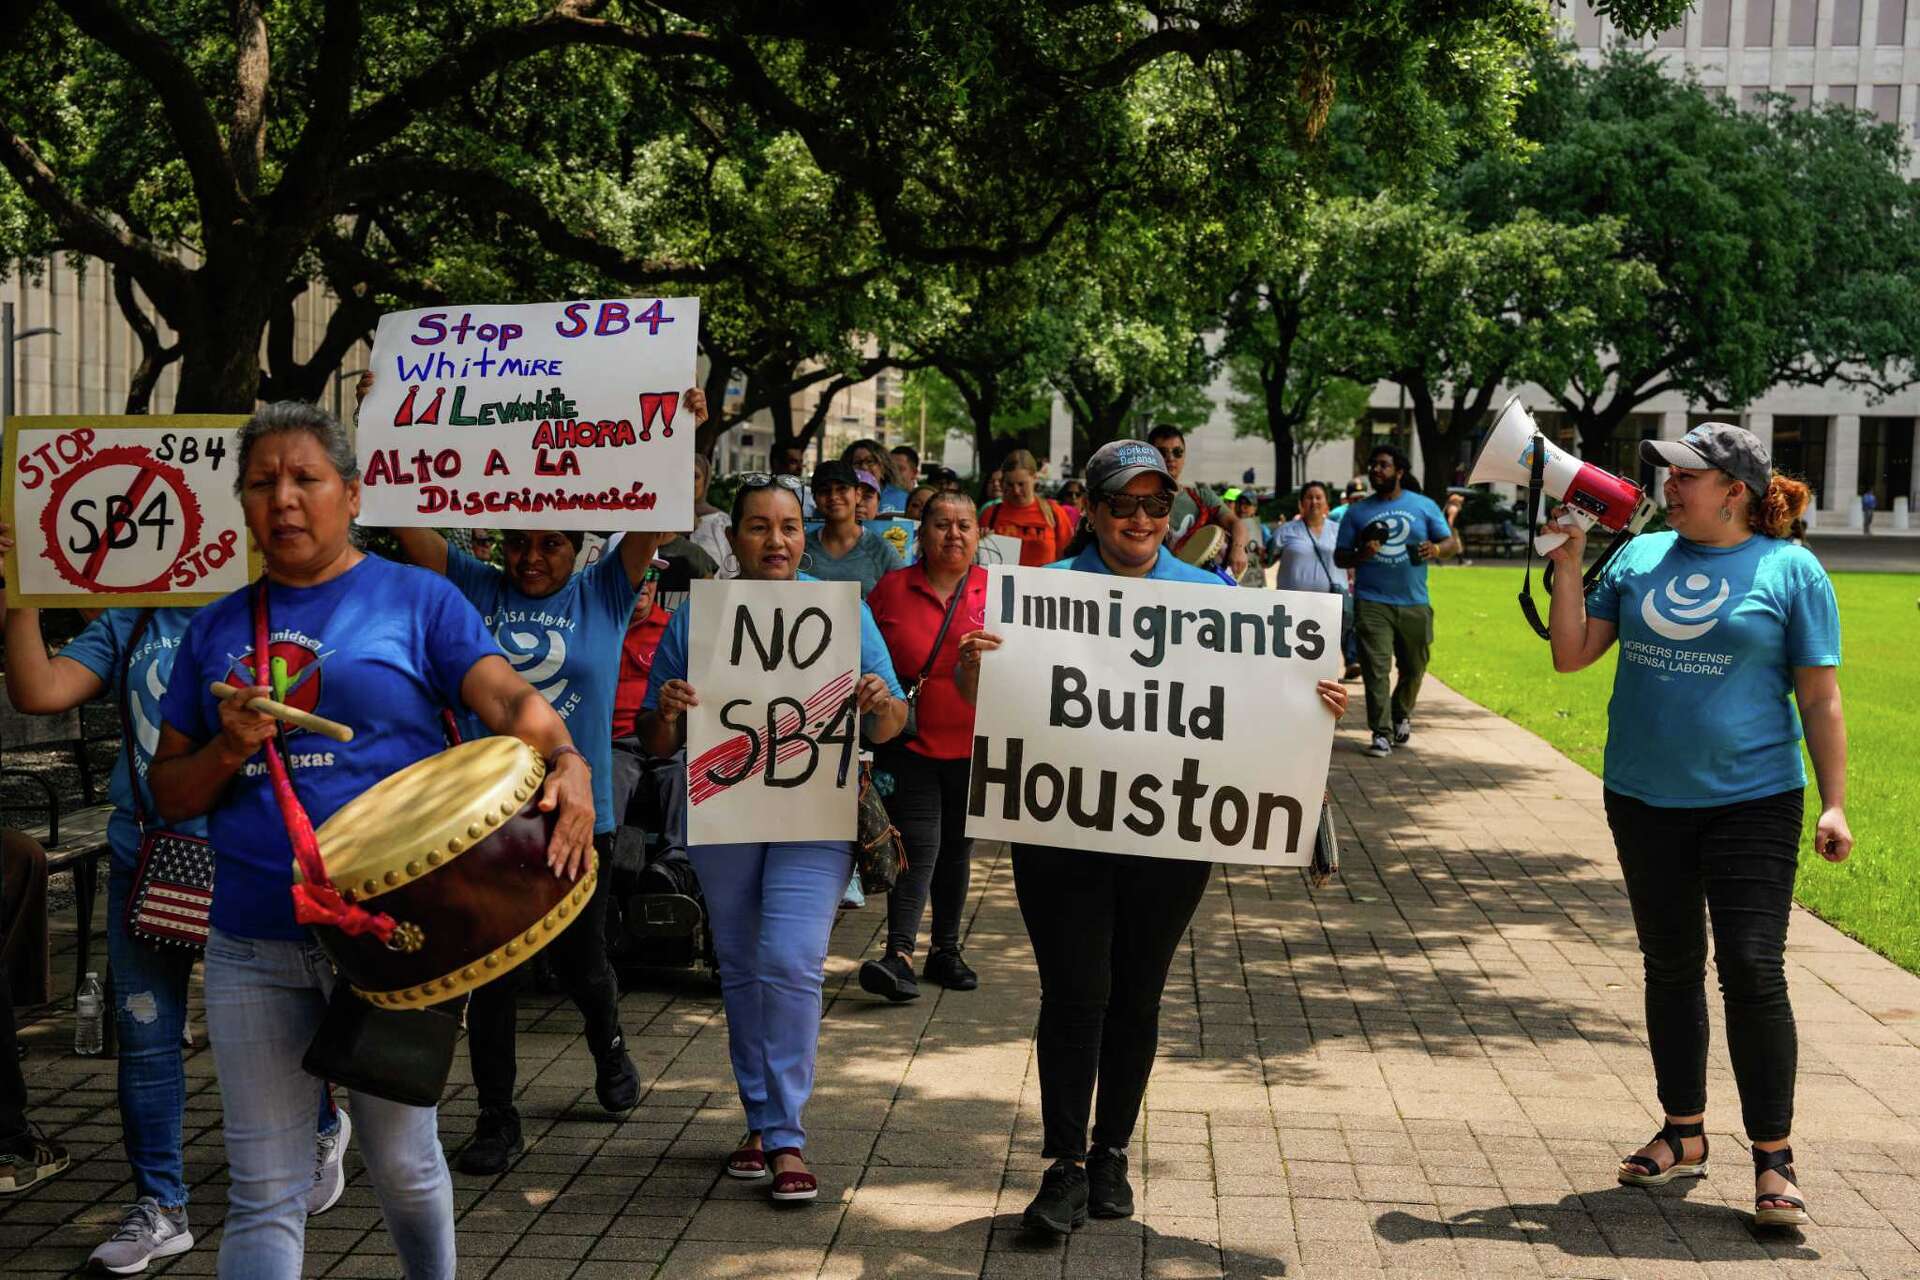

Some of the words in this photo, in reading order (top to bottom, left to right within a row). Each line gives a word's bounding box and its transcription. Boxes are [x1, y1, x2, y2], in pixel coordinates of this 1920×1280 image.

[411, 313, 523, 351] Stop
[555, 299, 675, 338] SB4
[18, 428, 96, 489] STOP
[156, 433, 226, 471] SB4
[484, 449, 510, 476] A
[534, 448, 581, 477] LA
[69, 491, 174, 554] SB4
[172, 529, 238, 588] STOP
[730, 604, 833, 672] NO
[1001, 575, 1326, 668] Immigrants
[1668, 661, 1725, 676] LABORAL
[1675, 650, 1734, 665] DEFENSE
[1049, 664, 1226, 741] Build
[279, 751, 335, 770] exas
[967, 735, 1304, 853] Houston
